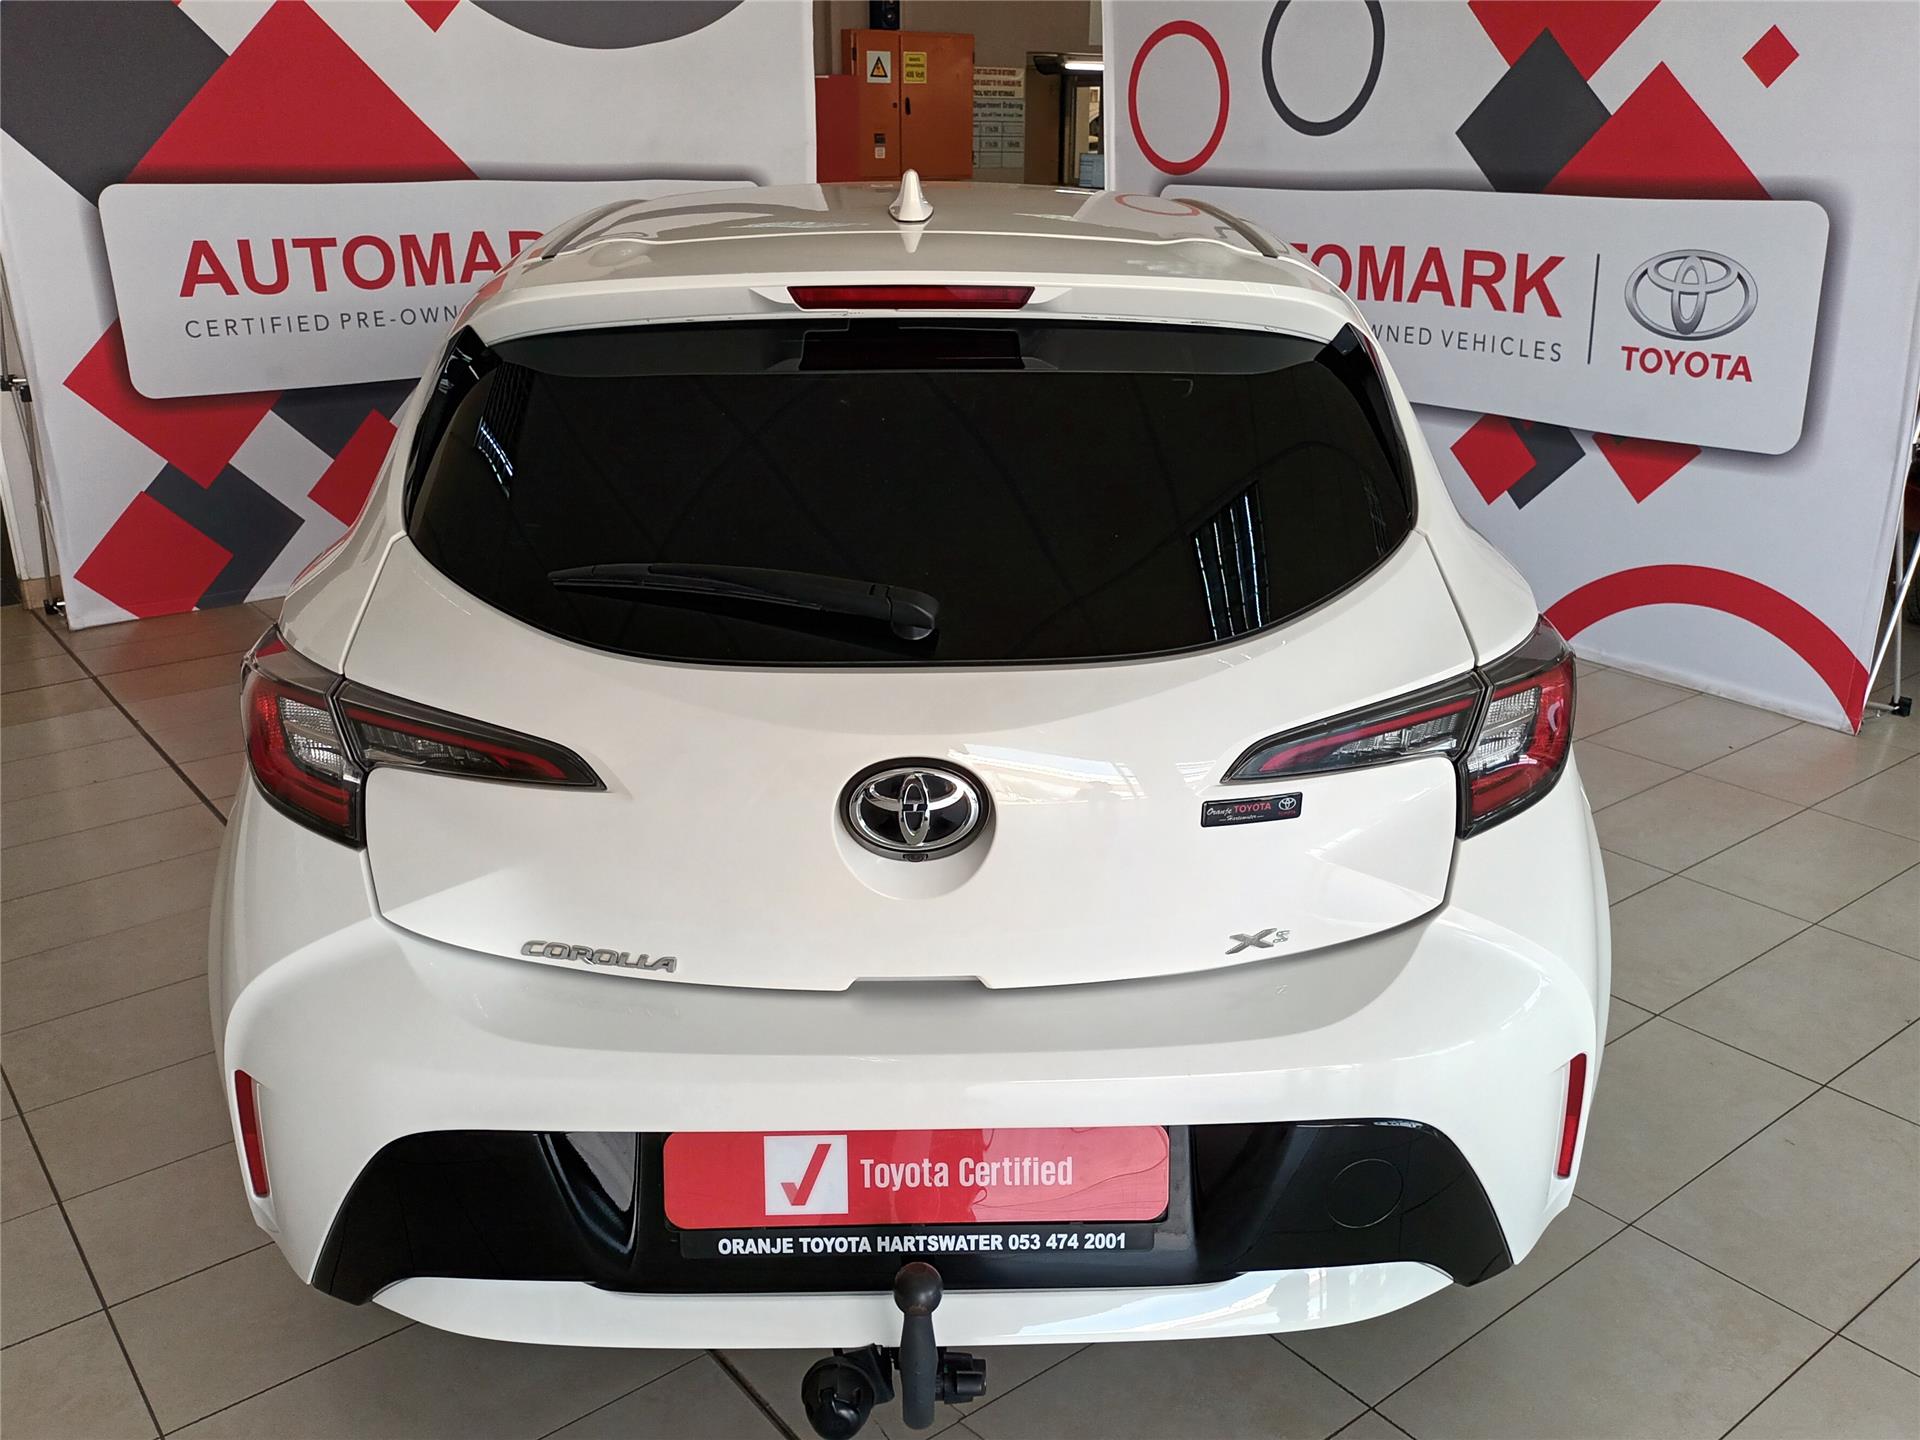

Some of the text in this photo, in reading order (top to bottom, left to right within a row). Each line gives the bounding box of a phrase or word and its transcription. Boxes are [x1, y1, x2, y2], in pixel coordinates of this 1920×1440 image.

[185, 305, 458, 338] CERTIFIED PRE-OWN
[1441, 328, 1562, 363] VEHICLES
[1622, 345, 1752, 383] TOYOTA
[1233, 802, 1271, 813] TOYOTA
[521, 940, 677, 973] COROLLA
[860, 1156, 1073, 1191] Toyota Certified
[718, 1232, 1126, 1255] ORANJE TOYOTA HARTSWATER 053 474 2001
